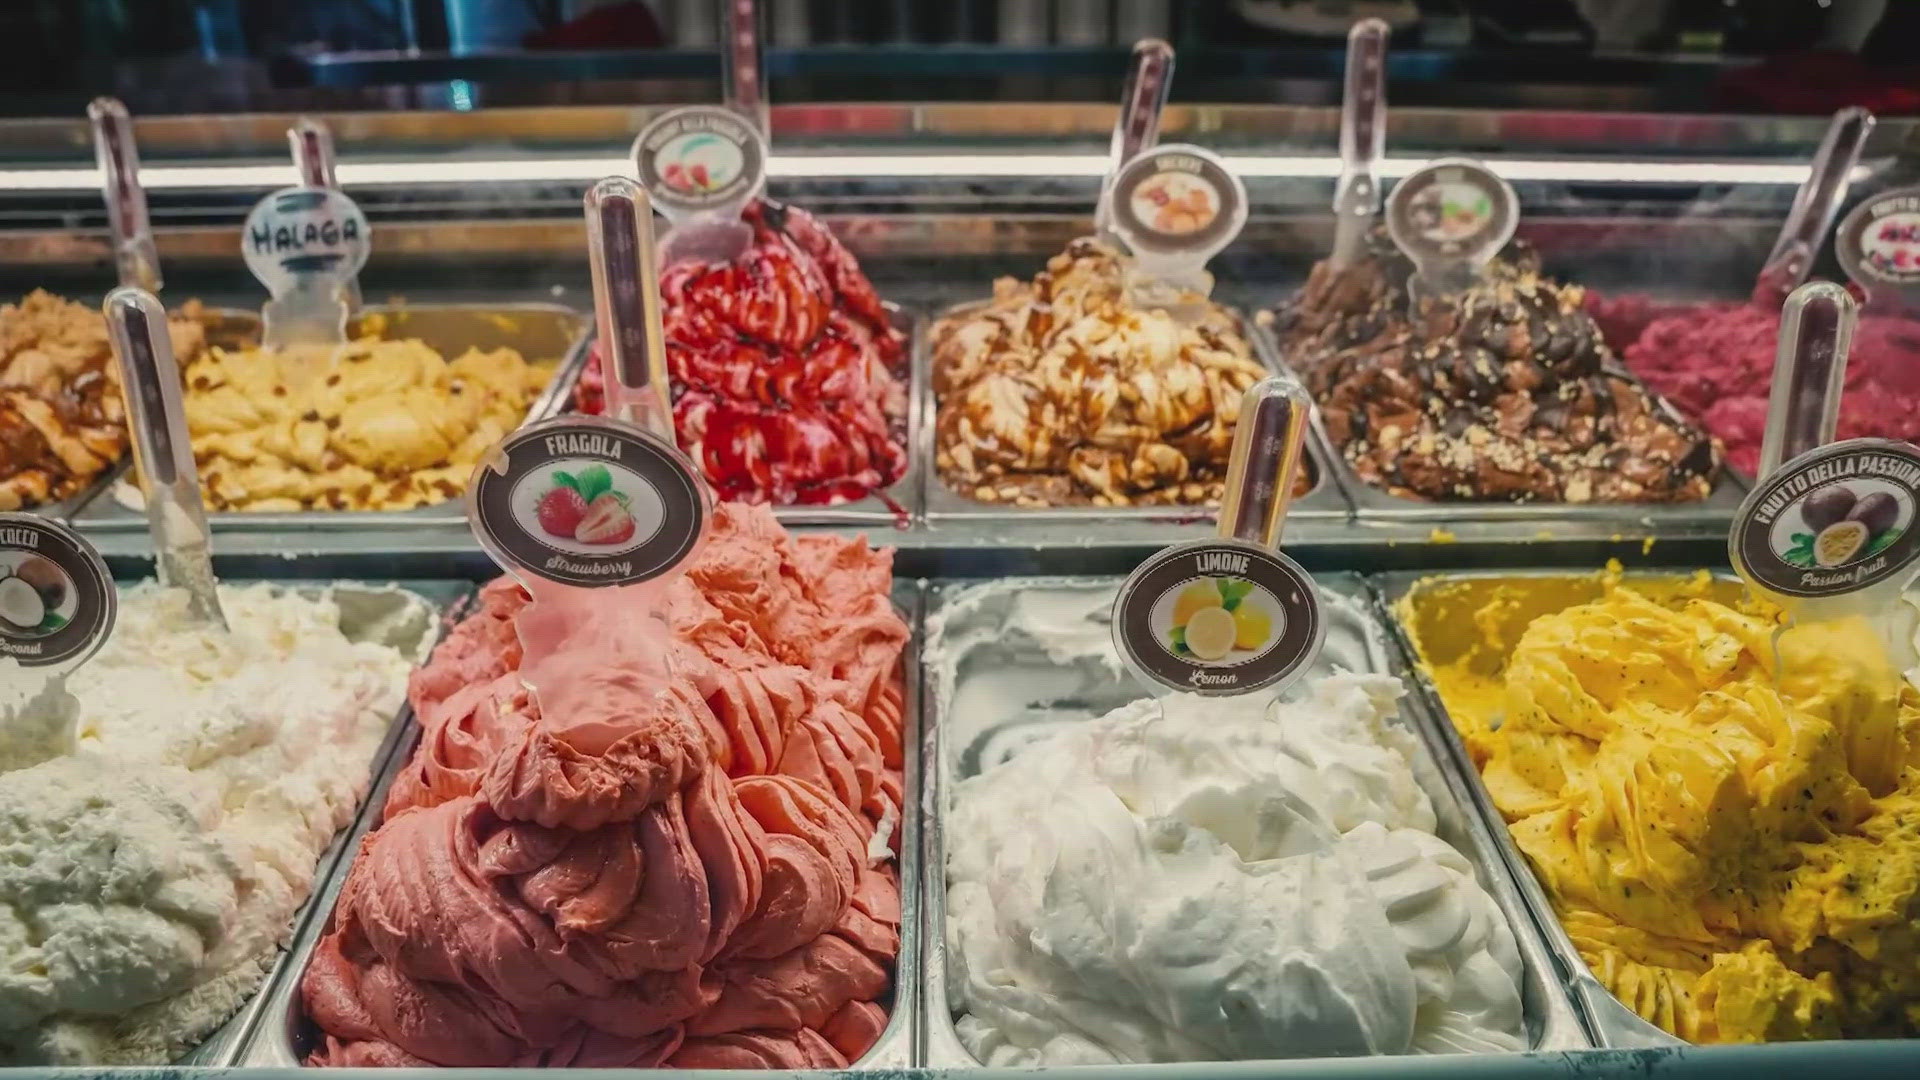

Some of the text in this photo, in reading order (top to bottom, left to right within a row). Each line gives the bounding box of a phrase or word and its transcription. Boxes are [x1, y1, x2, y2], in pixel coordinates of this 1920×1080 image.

[545, 434, 622, 459] FRAGOLA
[1754, 455, 1920, 525] FRUTTO DELLA PASSION
[0, 528, 38, 547] COCCO
[545, 555, 633, 576] Strawberry
[1195, 553, 1251, 574] LIMONE
[1800, 556, 1888, 587] Passion fruit
[1188, 668, 1239, 685] Lemon
